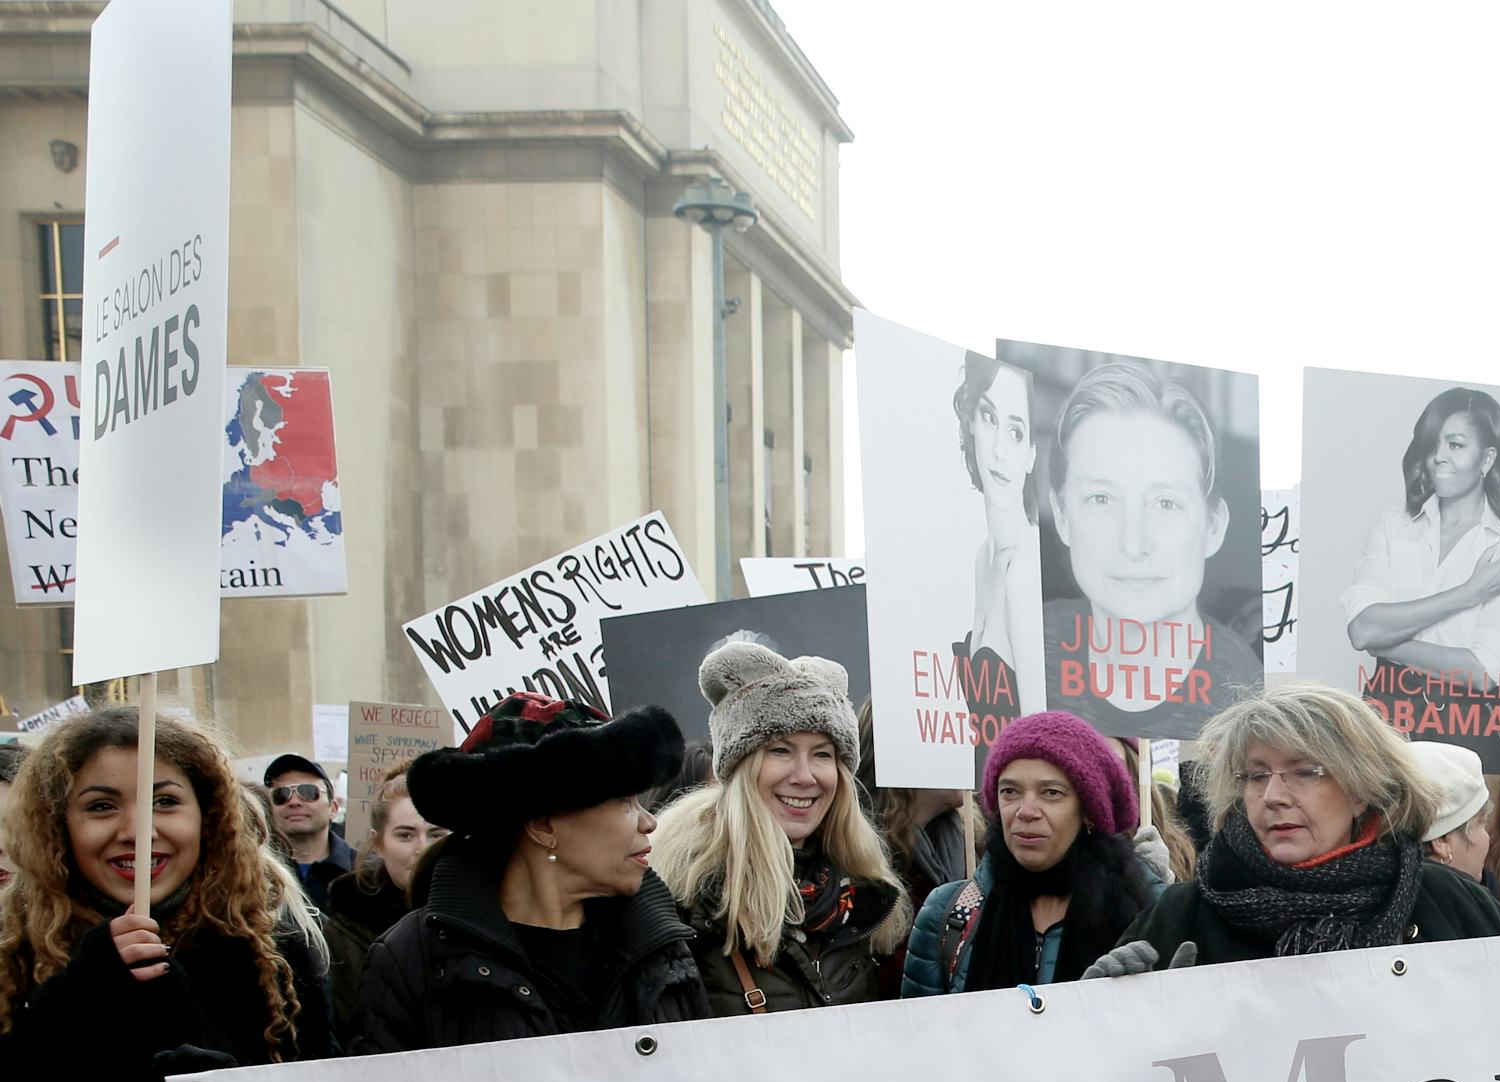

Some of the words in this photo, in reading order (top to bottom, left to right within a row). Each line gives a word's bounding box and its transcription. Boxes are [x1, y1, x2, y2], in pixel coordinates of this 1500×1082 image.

[97, 296, 109, 343] LE
[113, 258, 163, 331] SALON
[170, 233, 202, 296] DES
[95, 304, 201, 441] DAMES
[406, 570, 577, 674] WOMENS
[557, 519, 684, 609] RIGHTS
[793, 562, 865, 589] The
[538, 622, 582, 662] ARE
[1060, 614, 1213, 660] JUDITH
[913, 650, 1014, 706] EMMA
[1061, 660, 1213, 704] BUTLER
[361, 707, 384, 722] WE
[391, 709, 441, 727] REJECT
[371, 747, 425, 763] SEXIS
